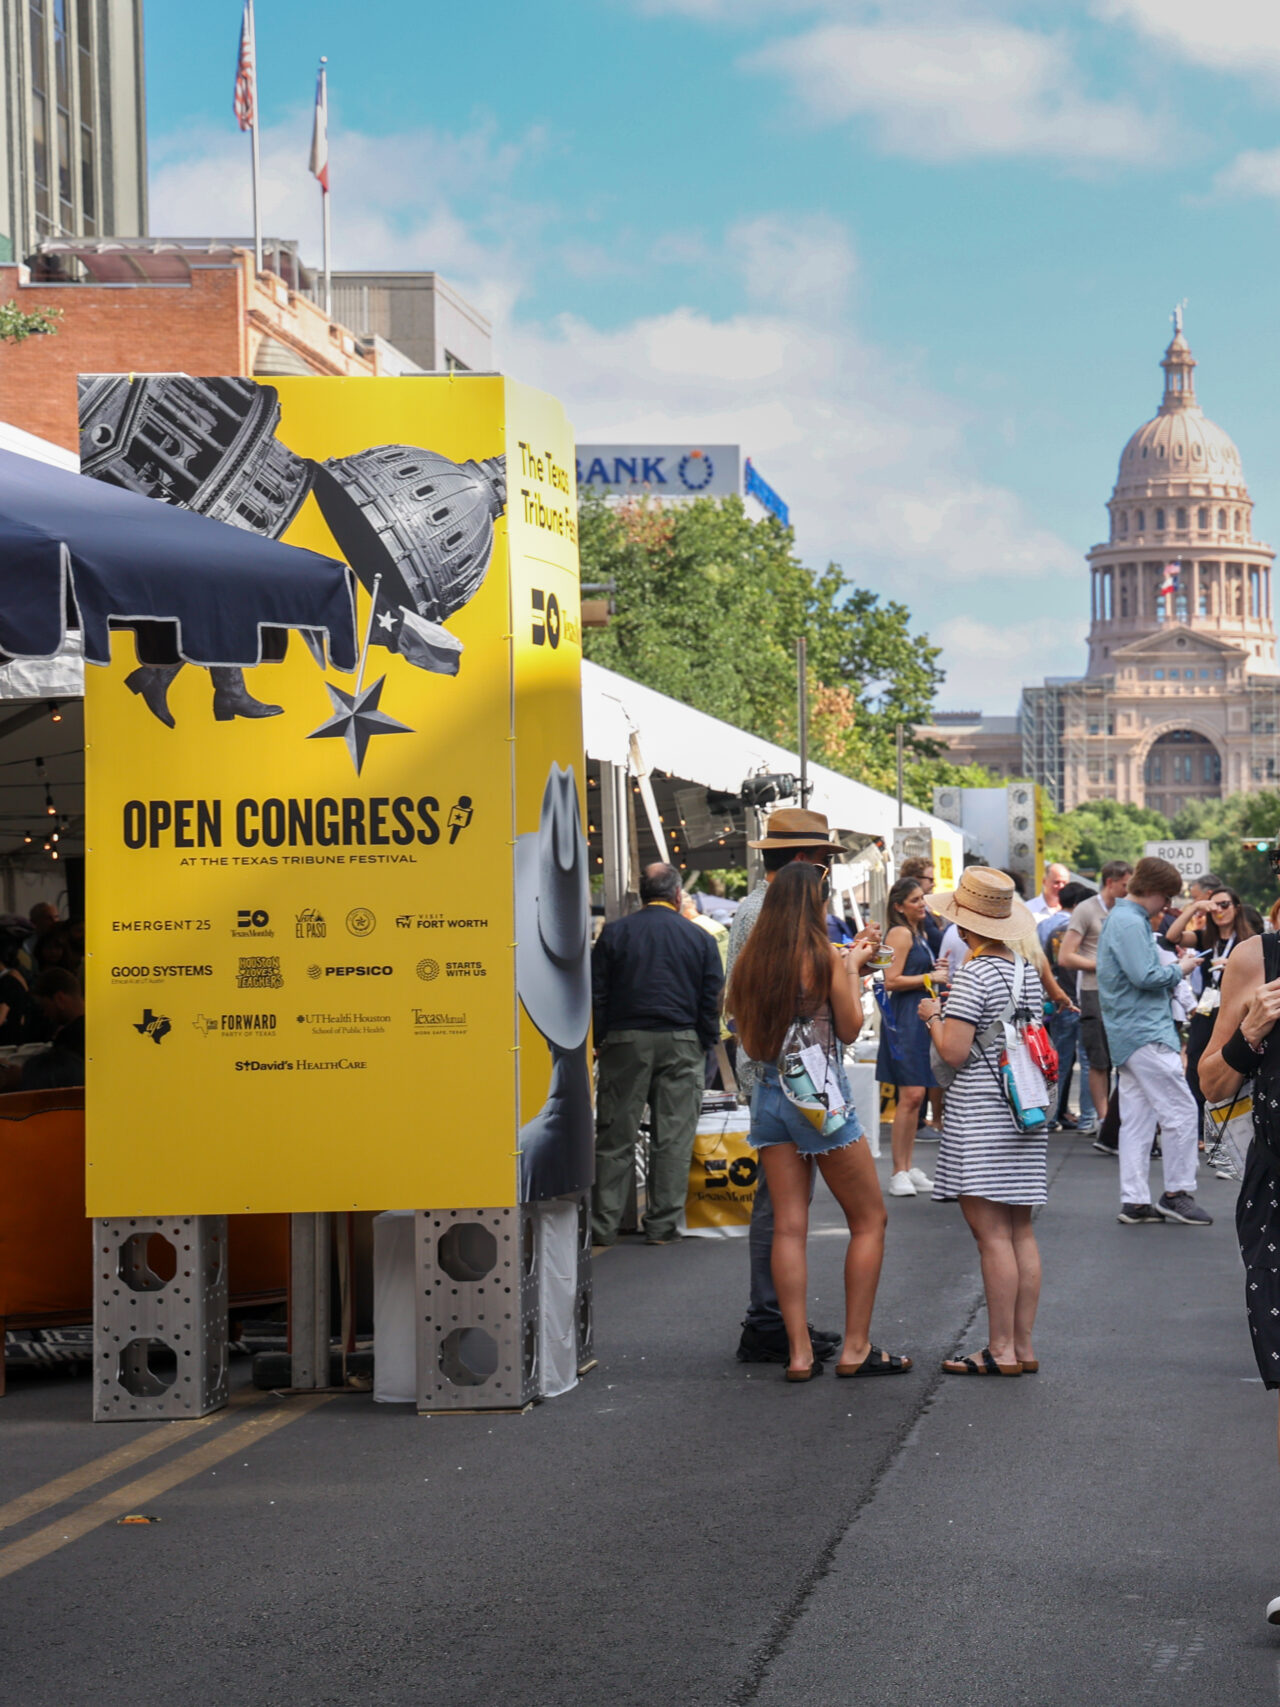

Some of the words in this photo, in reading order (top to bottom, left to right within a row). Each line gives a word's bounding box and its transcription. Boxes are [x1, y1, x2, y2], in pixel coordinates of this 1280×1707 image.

[518, 441, 544, 482] The
[544, 451, 570, 495] Texas
[521, 488, 564, 536] Tribune
[123, 799, 222, 849] OPEN
[235, 796, 441, 848] CONGRESS
[1157, 847, 1195, 859] ROAD
[180, 857, 198, 866] AT
[200, 857, 229, 866] THE
[232, 856, 279, 866] TEXAS
[282, 855, 345, 865] TRIBUNE
[349, 854, 417, 864] FESTIVAL
[112, 920, 193, 931] EMERGENT
[296, 922, 305, 938] EL
[306, 922, 327, 938] PASO
[417, 920, 445, 929] FORT
[447, 919, 489, 928] WORTH
[238, 956, 281, 969] HOUSTON
[445, 961, 482, 969] STARTS
[111, 966, 150, 978] GOOD
[153, 965, 214, 977] SYSTEMS
[325, 965, 393, 977] PEPSICO
[445, 969, 471, 977] WITH
[473, 969, 487, 977] US
[235, 974, 285, 989] TEACHERS
[221, 1014, 277, 1030] FORWARD
[353, 1013, 391, 1023] Houston
